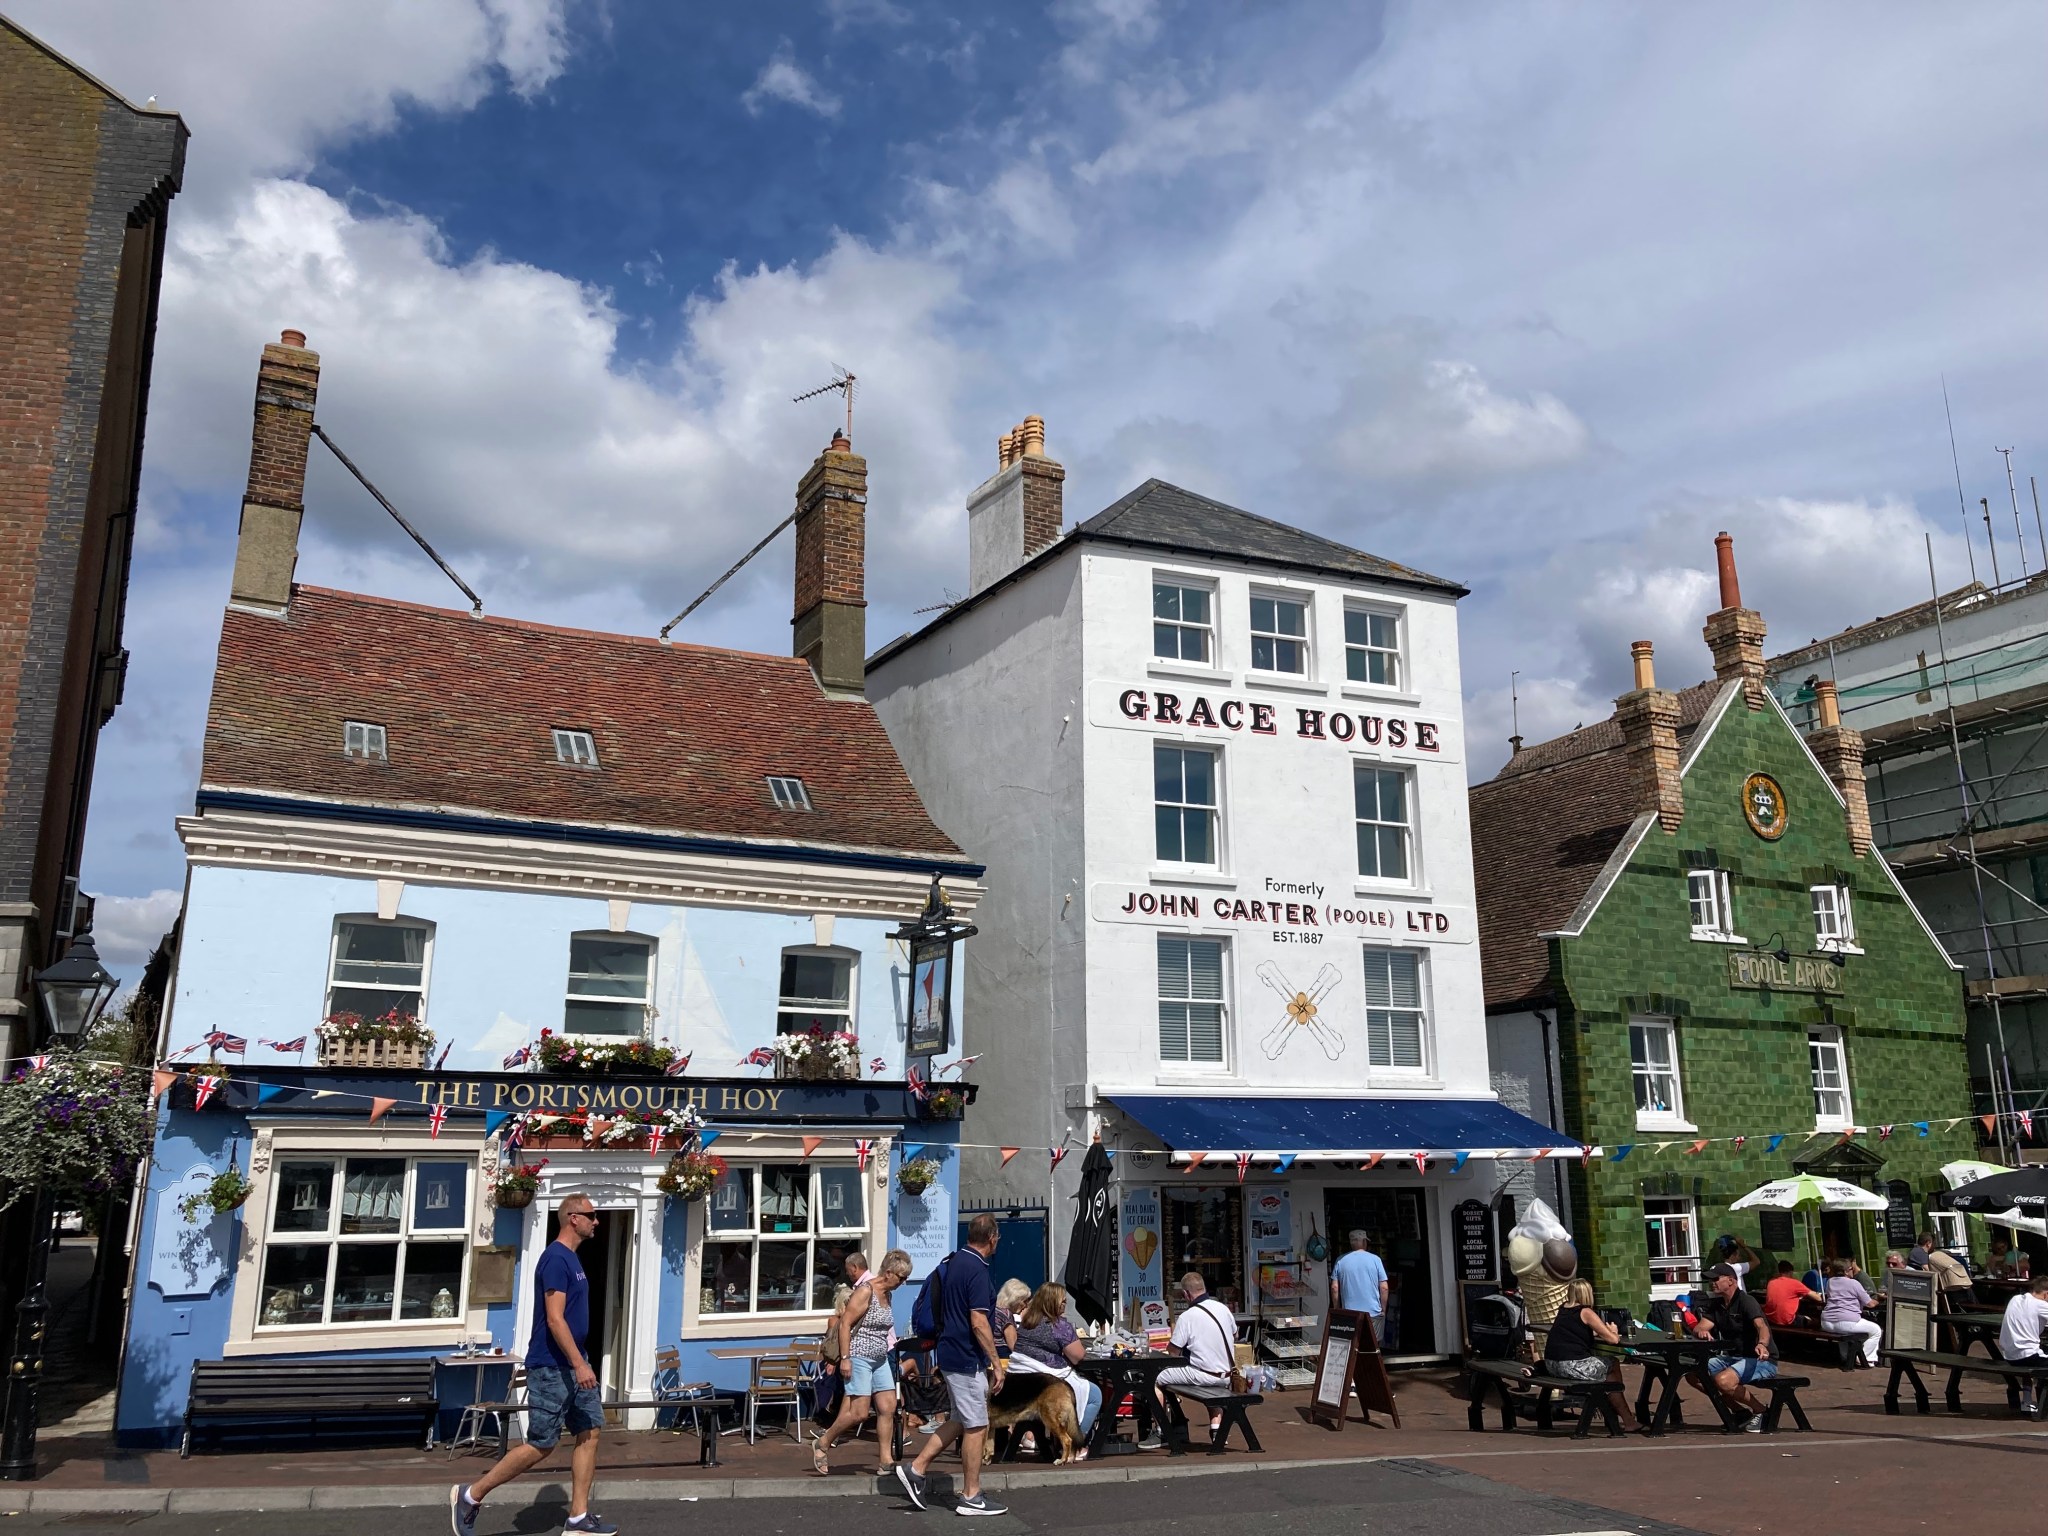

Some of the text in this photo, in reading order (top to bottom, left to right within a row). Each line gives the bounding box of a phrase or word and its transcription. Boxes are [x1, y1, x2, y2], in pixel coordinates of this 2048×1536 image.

[1119, 689, 1440, 752] GRACE HOUSE
[1265, 877, 1325, 900] Formerly
[1121, 892, 1450, 933] JOHN CARTER (POOLE) LTD
[1737, 955, 1836, 989] POOLE ARMS
[415, 1081, 784, 1111] THE PORTSMOUTH HOY
[1125, 1205, 1156, 1214] REAL DAIRY
[1127, 1215, 1155, 1225] ICE CREAM
[1139, 1272, 1147, 1282] 30
[1128, 1285, 1157, 1297] FLAVOURS
